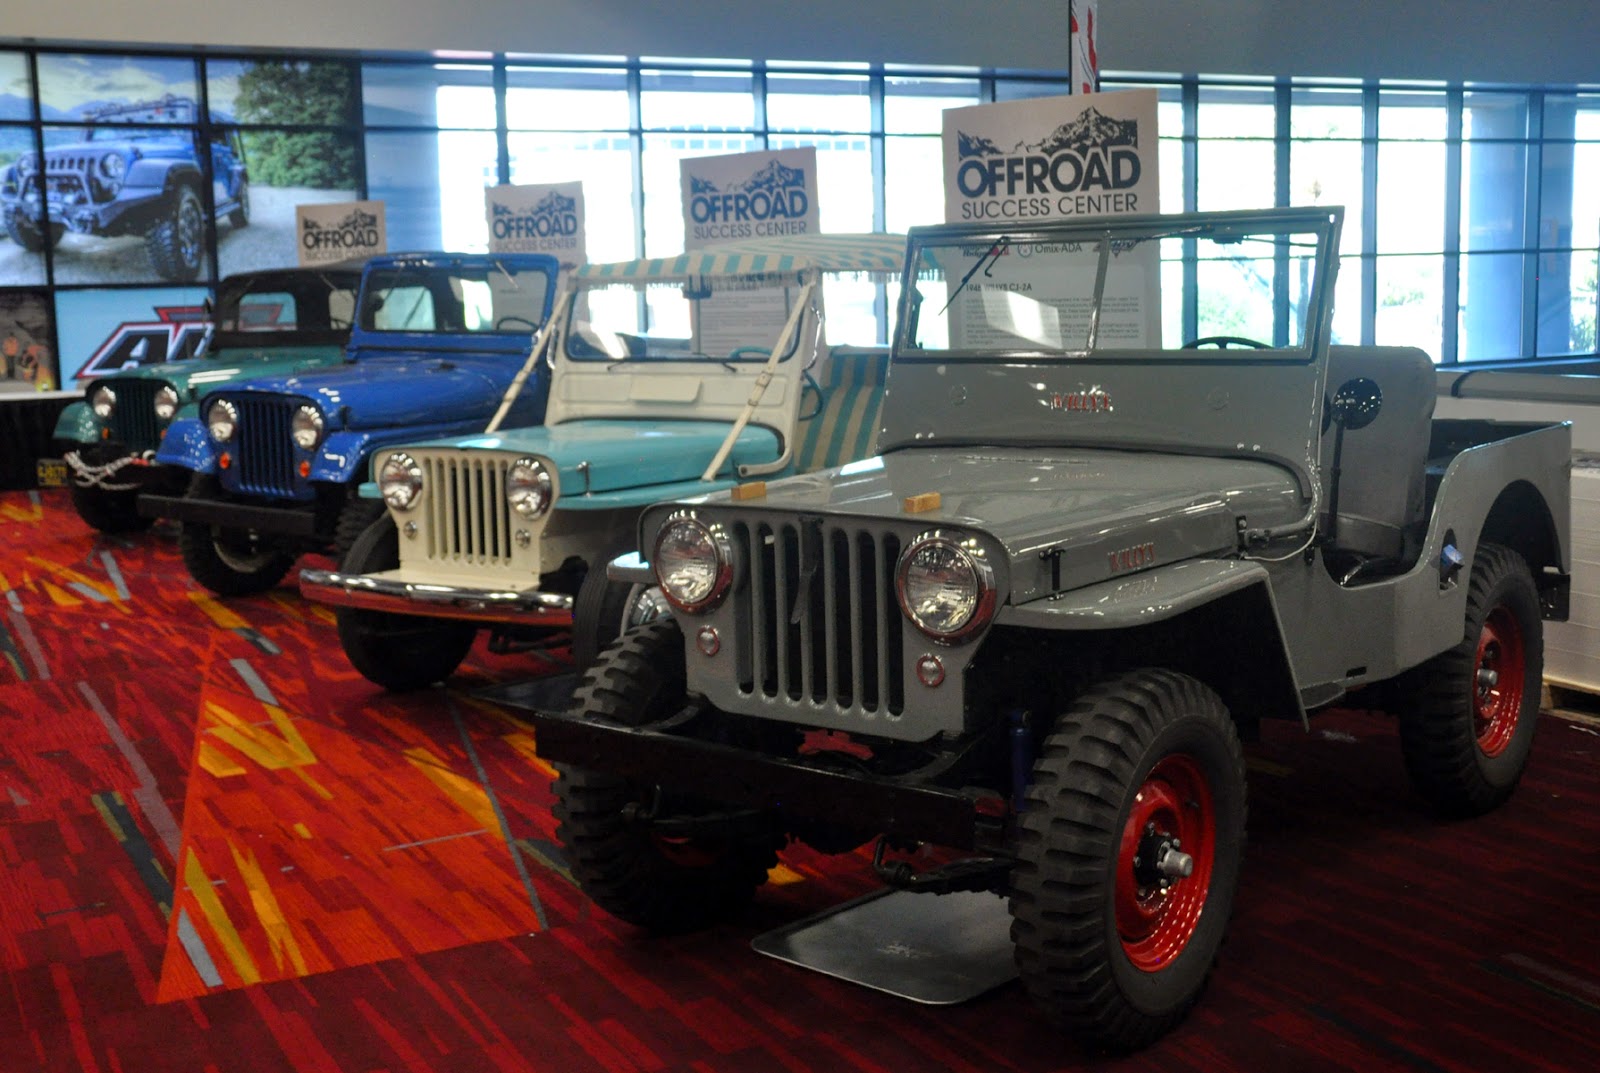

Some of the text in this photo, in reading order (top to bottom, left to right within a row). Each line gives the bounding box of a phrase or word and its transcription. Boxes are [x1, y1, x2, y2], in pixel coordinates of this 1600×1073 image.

[957, 149, 1141, 198] OFFROAD
[690, 188, 808, 223] OFFROAD
[962, 193, 1138, 220] SUCCESS CENTER
[493, 213, 577, 239] OFFROAD
[694, 220, 807, 240] SUCCESS CENTER
[303, 229, 379, 250] OFFROAD
